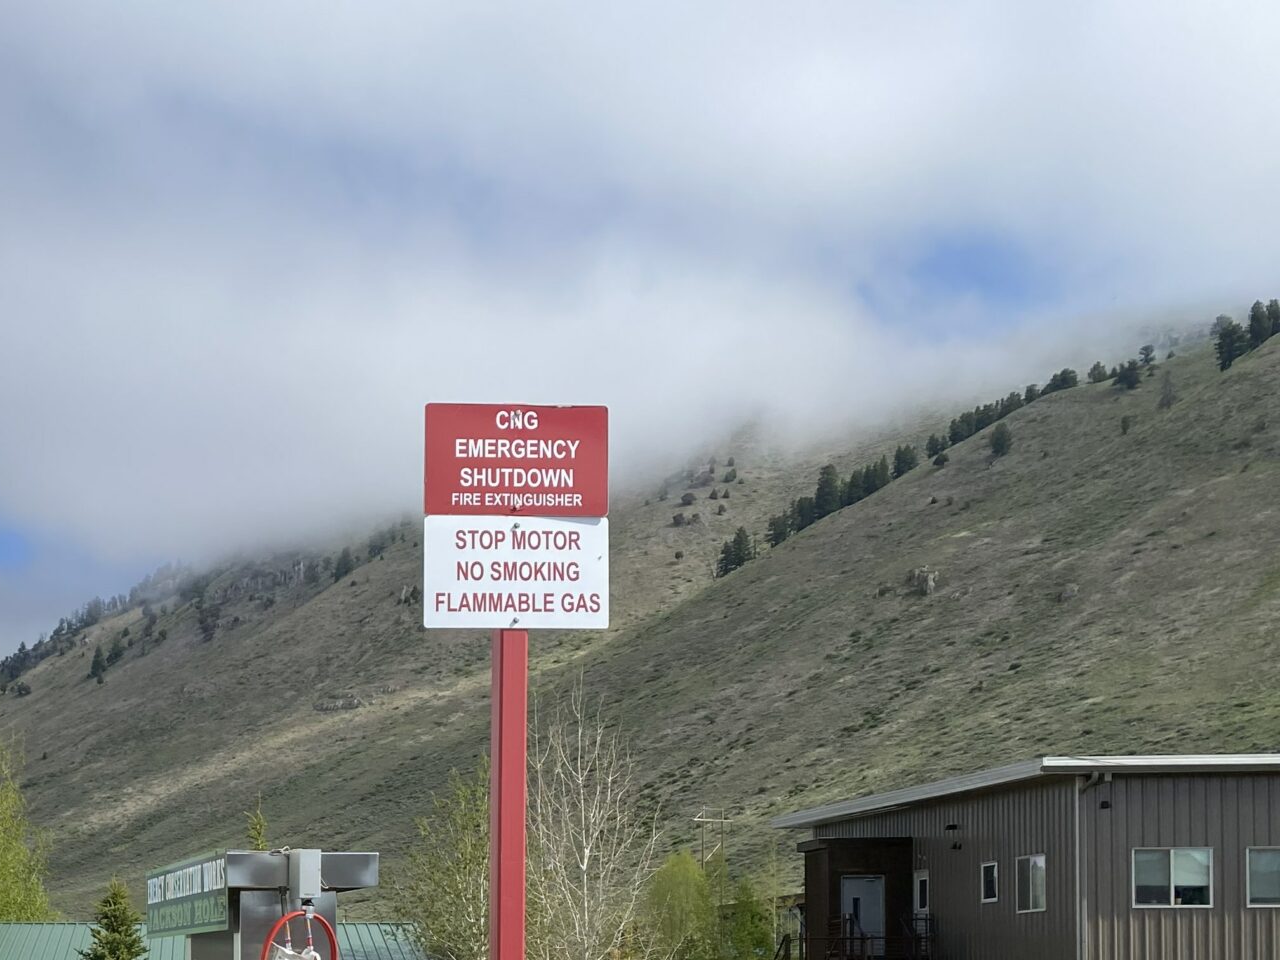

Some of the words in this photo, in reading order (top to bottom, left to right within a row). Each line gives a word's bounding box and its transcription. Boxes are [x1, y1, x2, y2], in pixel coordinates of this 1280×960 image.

[495, 411, 539, 429] CNG
[455, 438, 580, 459] EMERGENCY
[459, 468, 574, 487] SHUTDOWN
[451, 493, 481, 506] FIRE
[485, 493, 583, 507] EXTINGUISHER
[455, 530, 506, 550] STOP
[512, 530, 581, 550] MOTOR
[456, 561, 484, 581] NO
[490, 561, 580, 581] SMOKING
[435, 592, 555, 612] FLAMMABLE
[561, 593, 601, 613] GAS
[203, 858, 225, 892] WORKS
[148, 901, 192, 932] JACKSON
[194, 895, 225, 925] HOLE
